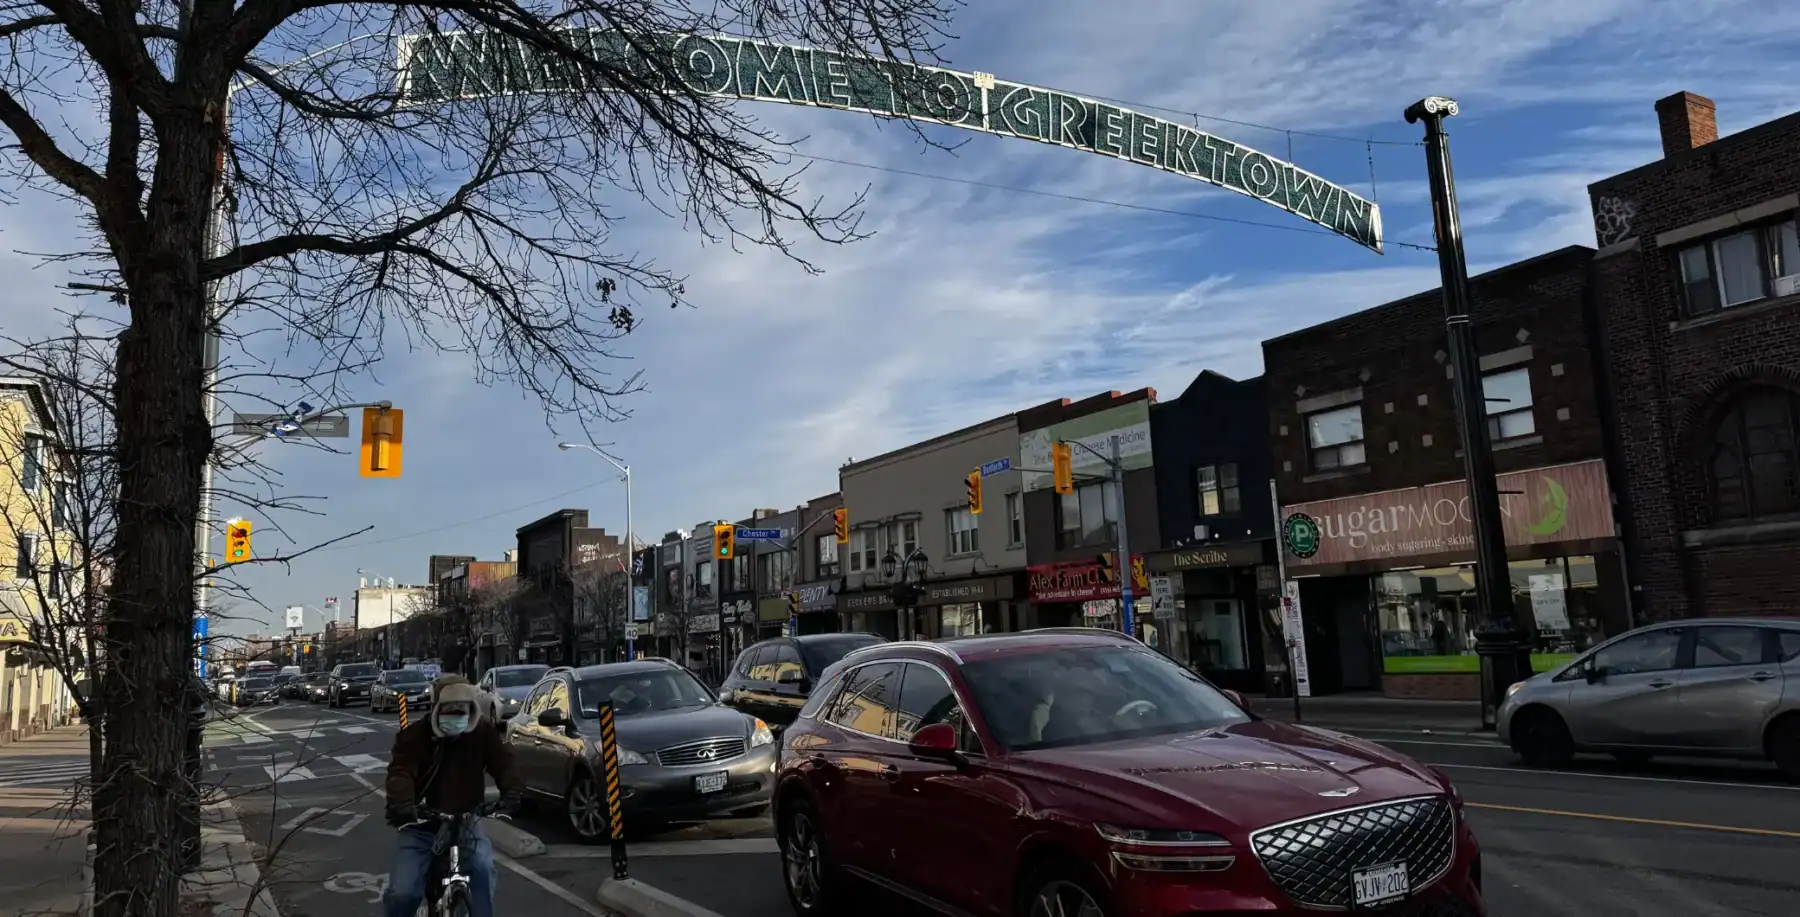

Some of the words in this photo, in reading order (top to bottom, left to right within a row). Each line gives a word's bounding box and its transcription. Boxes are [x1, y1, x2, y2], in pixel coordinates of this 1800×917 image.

[868, 57, 972, 121] TO
[1000, 87, 1378, 247] GREEKTOWN
[1106, 430, 1146, 451] Mdicine
[742, 529, 769, 538] Chester
[1397, 535, 1440, 553] sugaring
[1173, 553, 1191, 566] The
[1191, 550, 1228, 565] Scribe
[1029, 573, 1054, 590] Alex
[1056, 571, 1083, 589] Farm
[931, 587, 970, 599] ESTABLISHED
[626, 630, 638, 638] 40
[1387, 871, 1409, 893] 202
